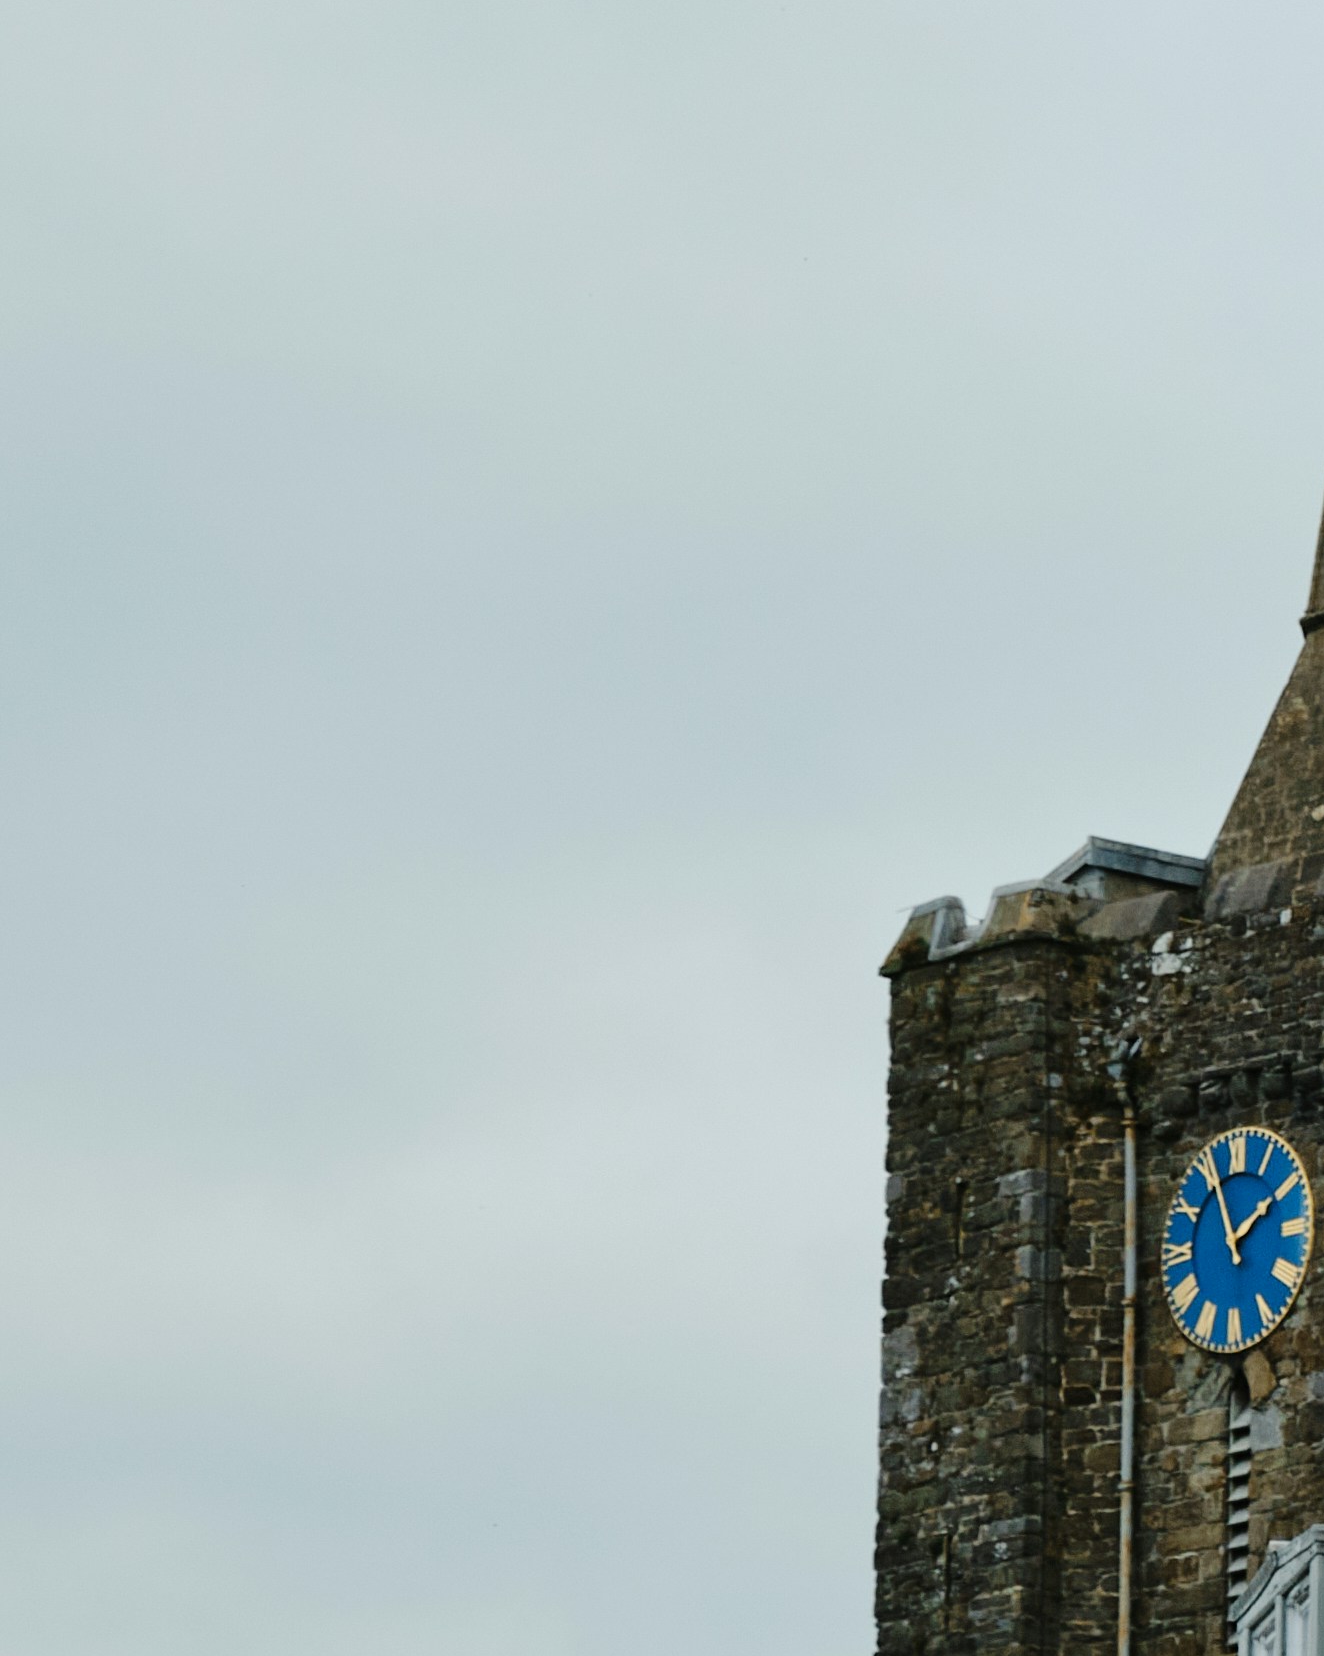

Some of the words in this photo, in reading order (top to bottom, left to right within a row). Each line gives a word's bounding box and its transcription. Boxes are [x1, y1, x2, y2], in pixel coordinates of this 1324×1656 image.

[1229, 1137, 1246, 1176] XII
[1258, 1142, 1275, 1177] I
[1274, 1172, 1299, 1201] II
[1174, 1197, 1200, 1223] X
[1281, 1217, 1305, 1238] III
[1227, 1307, 1241, 1345] VI
[1255, 1293, 1274, 1326] V
